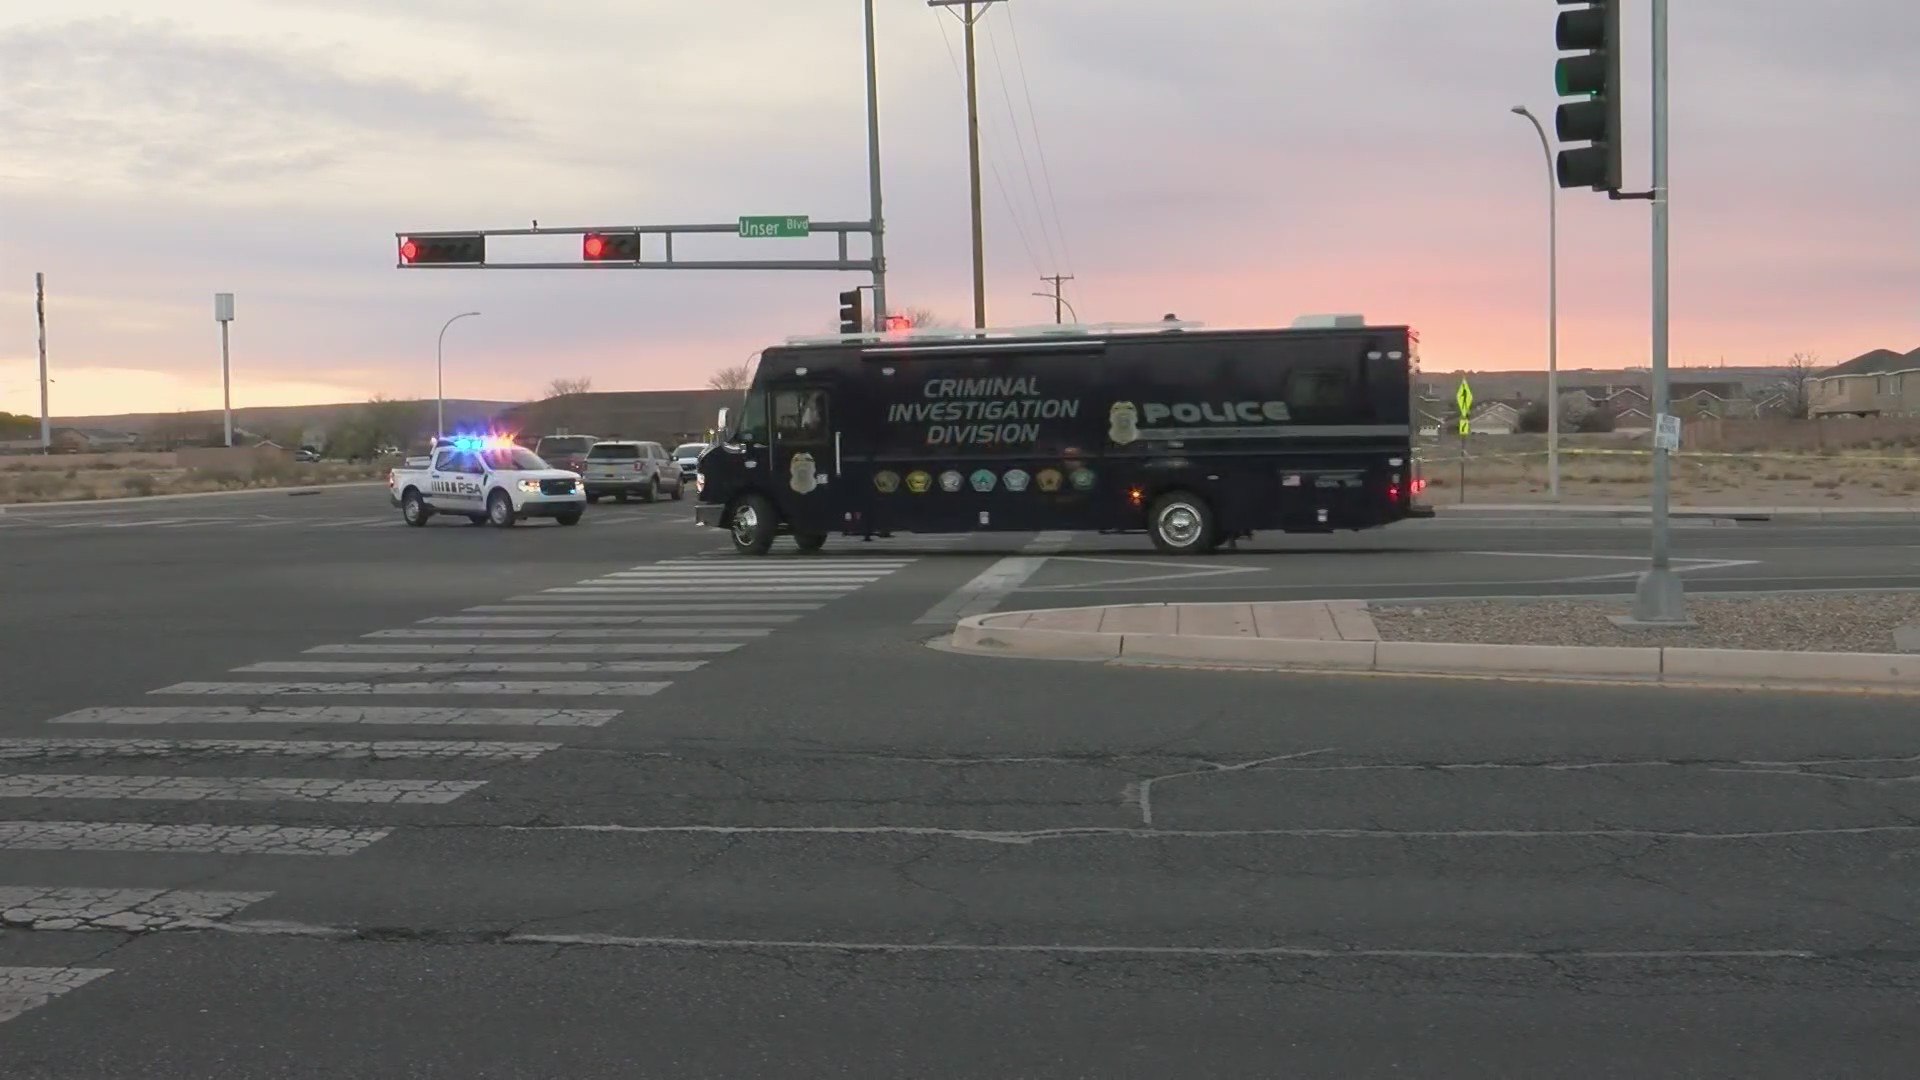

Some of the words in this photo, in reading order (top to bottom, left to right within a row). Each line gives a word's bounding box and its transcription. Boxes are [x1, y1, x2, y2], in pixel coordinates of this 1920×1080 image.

[740, 220, 779, 236] Unser
[786, 218, 808, 230] Blvd
[924, 376, 1041, 398] CRIMINAL
[888, 399, 1080, 422] INVESTIGATION
[1143, 401, 1291, 423] POLICE
[926, 423, 1040, 444] DIVISION
[458, 482, 482, 494] PSA
